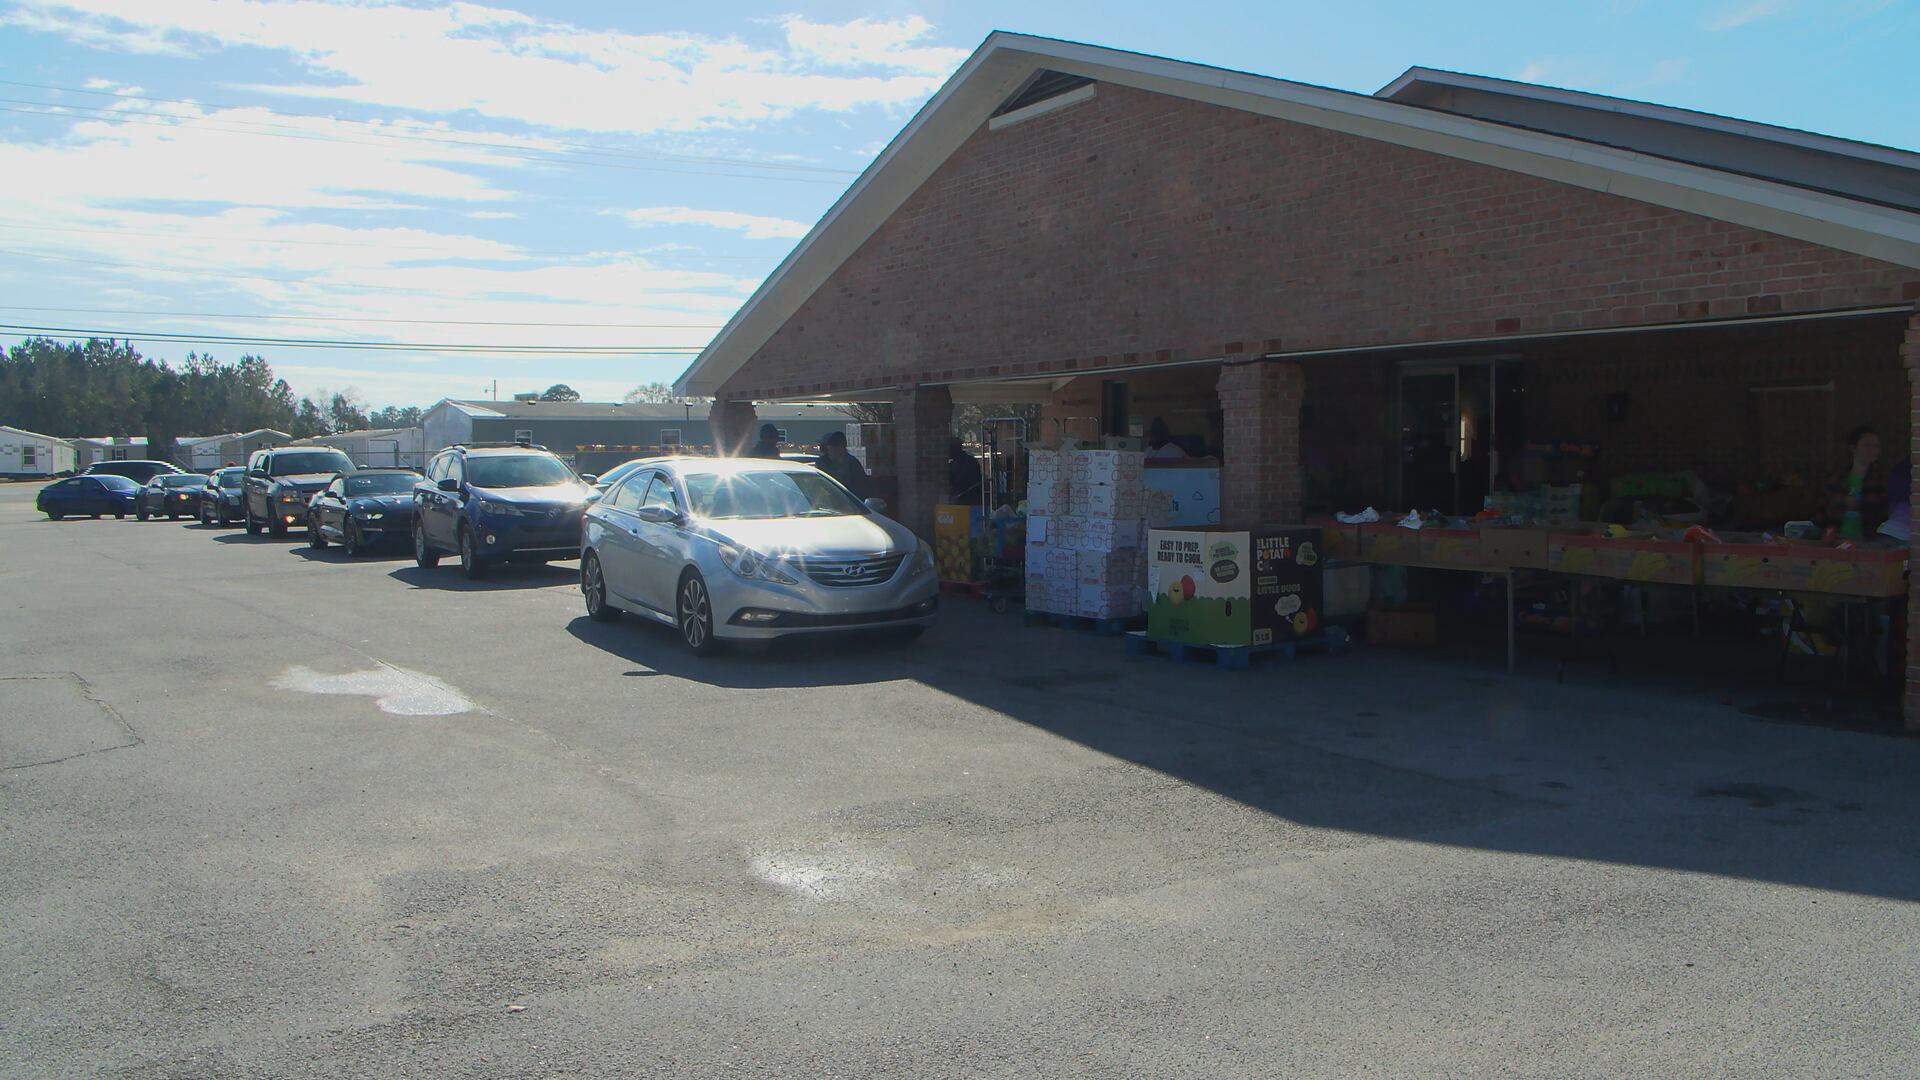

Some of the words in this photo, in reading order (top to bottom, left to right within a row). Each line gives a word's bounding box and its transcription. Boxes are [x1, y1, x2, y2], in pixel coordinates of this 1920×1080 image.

[1160, 540, 1174, 551] EASY
[1175, 541, 1183, 551] TO
[1184, 541, 1200, 553] PREP.
[1261, 537, 1289, 549] LITTLE
[1157, 551, 1175, 562] READY
[1176, 553, 1183, 563] TO
[1184, 553, 1203, 565] COOK.
[1256, 548, 1291, 560] POTATO
[1257, 585, 1279, 595] LITTLE
